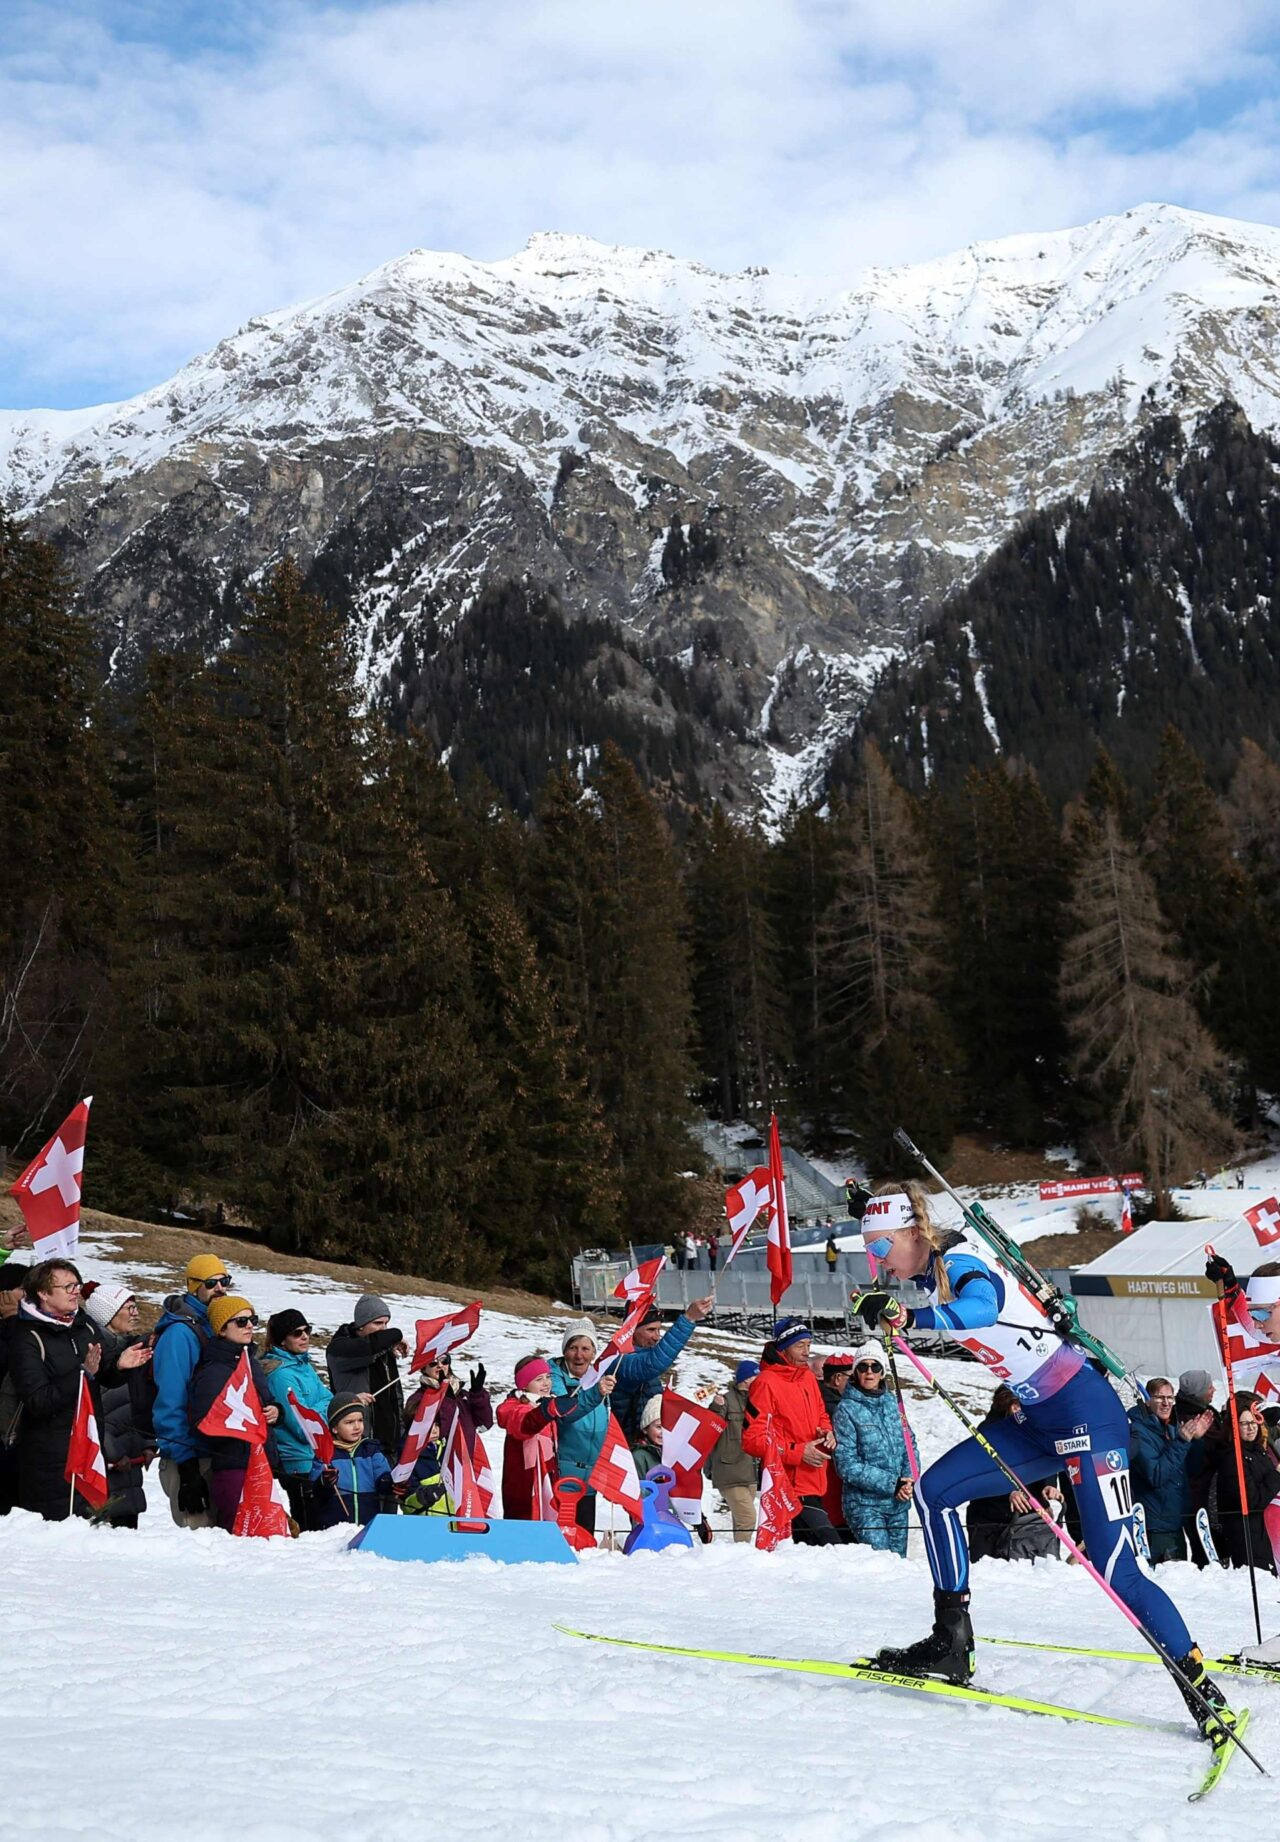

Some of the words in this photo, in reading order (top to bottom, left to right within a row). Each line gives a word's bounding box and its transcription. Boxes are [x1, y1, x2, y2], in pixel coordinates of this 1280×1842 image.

[1091, 1177, 1143, 1191] VIESSANN
[1127, 1281, 1176, 1294] HARTWEG
[1177, 1282, 1201, 1295] HILL
[1063, 1439, 1088, 1451] STARK
[1109, 1474, 1130, 1515] 10
[855, 1670, 926, 1689] FISCHER
